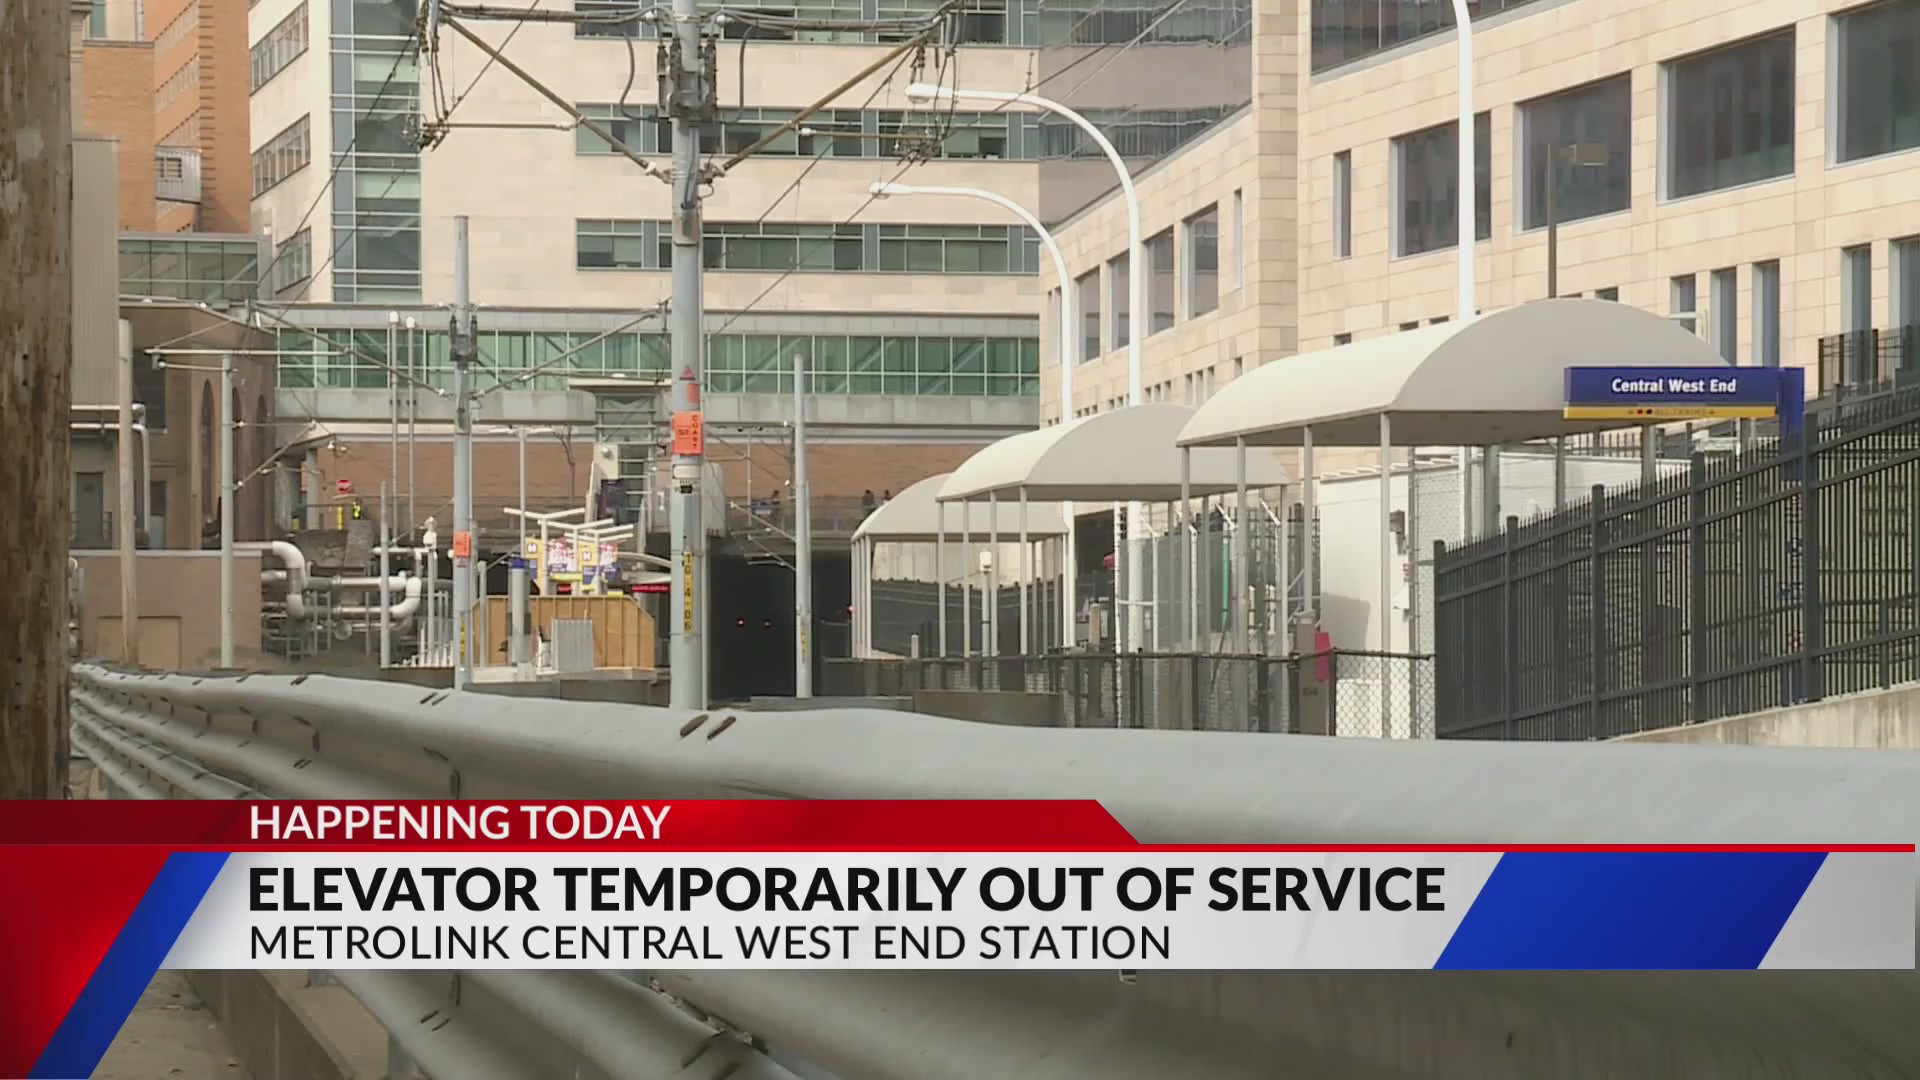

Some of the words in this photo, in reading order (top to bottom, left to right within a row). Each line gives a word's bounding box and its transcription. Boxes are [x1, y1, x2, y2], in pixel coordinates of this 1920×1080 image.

[1611, 377, 1664, 393] Central
[1668, 378, 1705, 393] West
[1709, 378, 1737, 393] End
[691, 414, 699, 449] COAST
